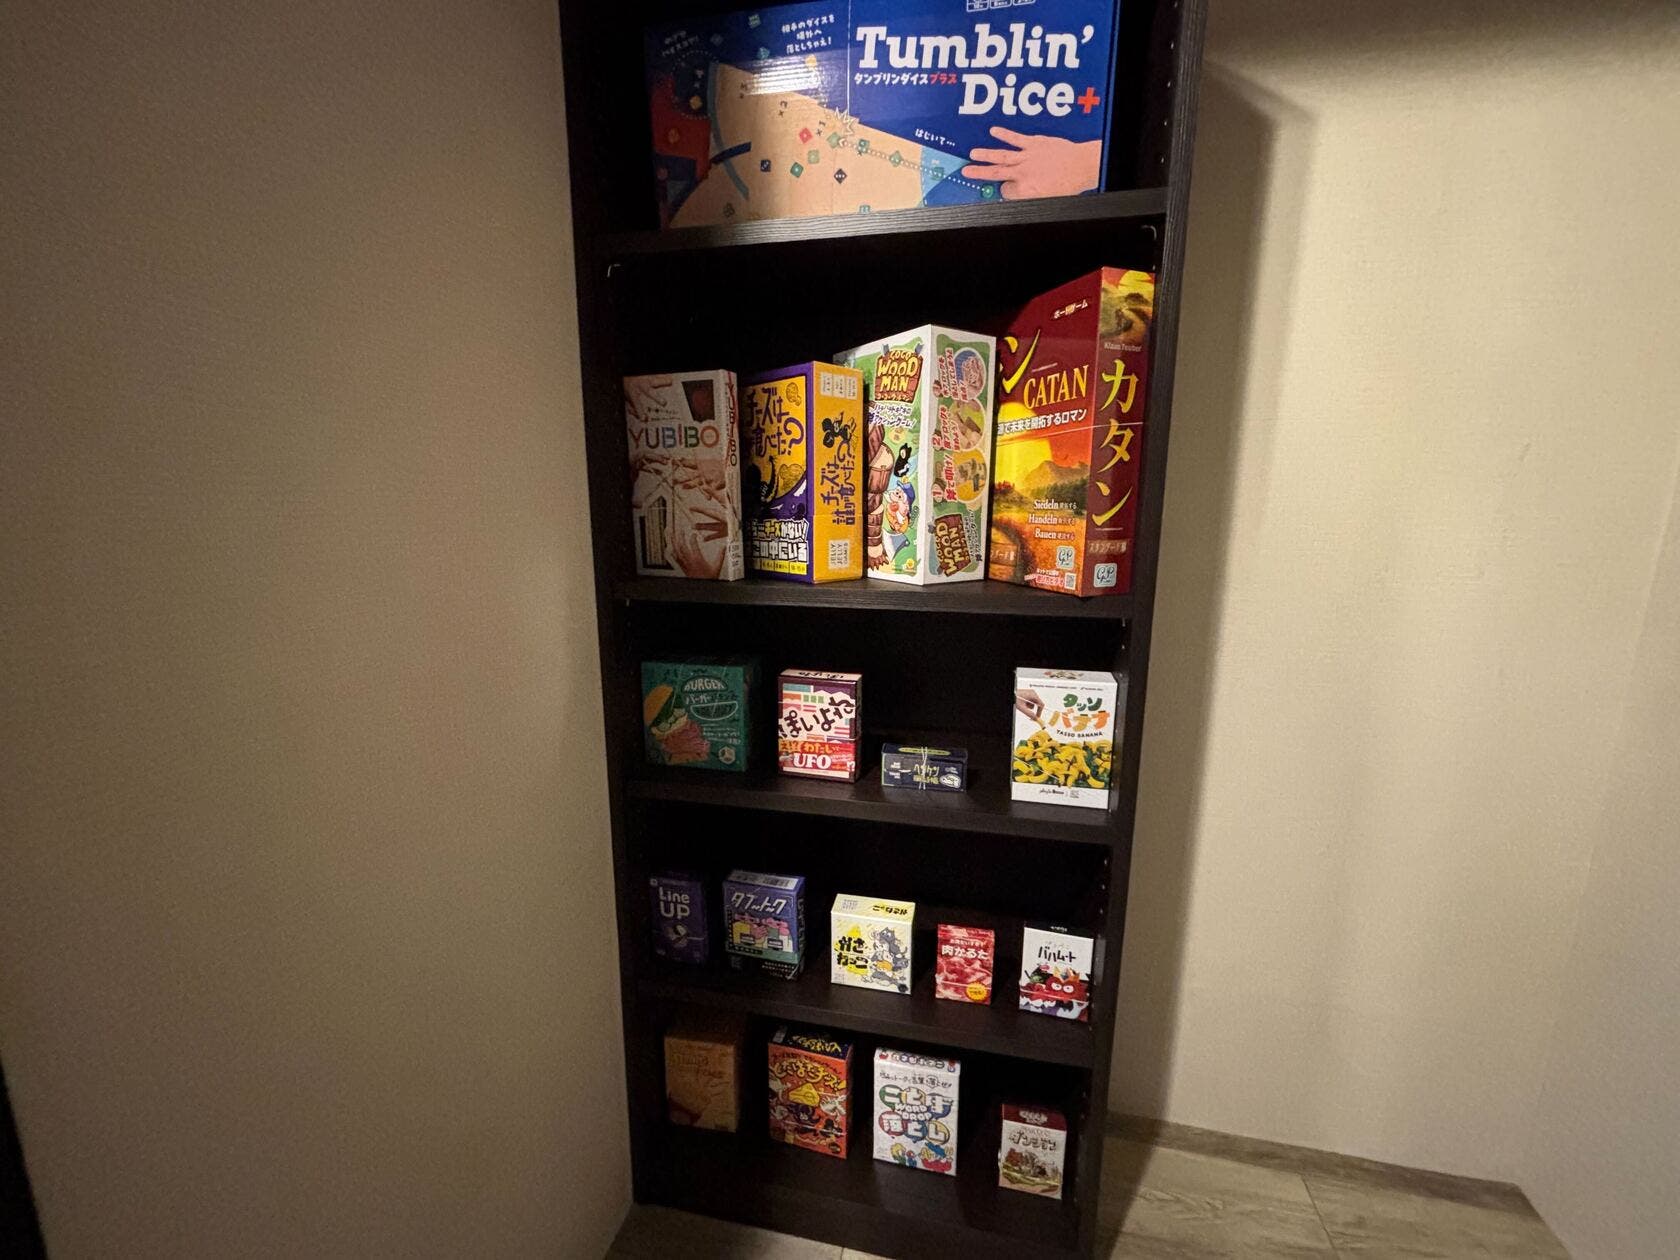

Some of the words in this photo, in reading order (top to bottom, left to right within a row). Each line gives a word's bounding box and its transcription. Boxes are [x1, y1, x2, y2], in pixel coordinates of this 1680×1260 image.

[877, 356, 919, 377] WOOD
[880, 375, 910, 392] MAN
[1023, 364, 1089, 410] CATAN
[728, 384, 737, 466] YUBIBO
[628, 424, 720, 449] YUBIBO
[1092, 358, 1139, 526] カタン
[936, 522, 958, 574] WOOD
[949, 527, 965, 562] MAN
[1056, 729, 1076, 739] TASSO
[1077, 730, 1104, 739] BANANA
[793, 752, 832, 769] UFO
[659, 886, 690, 904] Line
[660, 900, 691, 920] UP
[942, 945, 989, 960] 肉かるた
[895, 1103, 928, 1113] WORD
